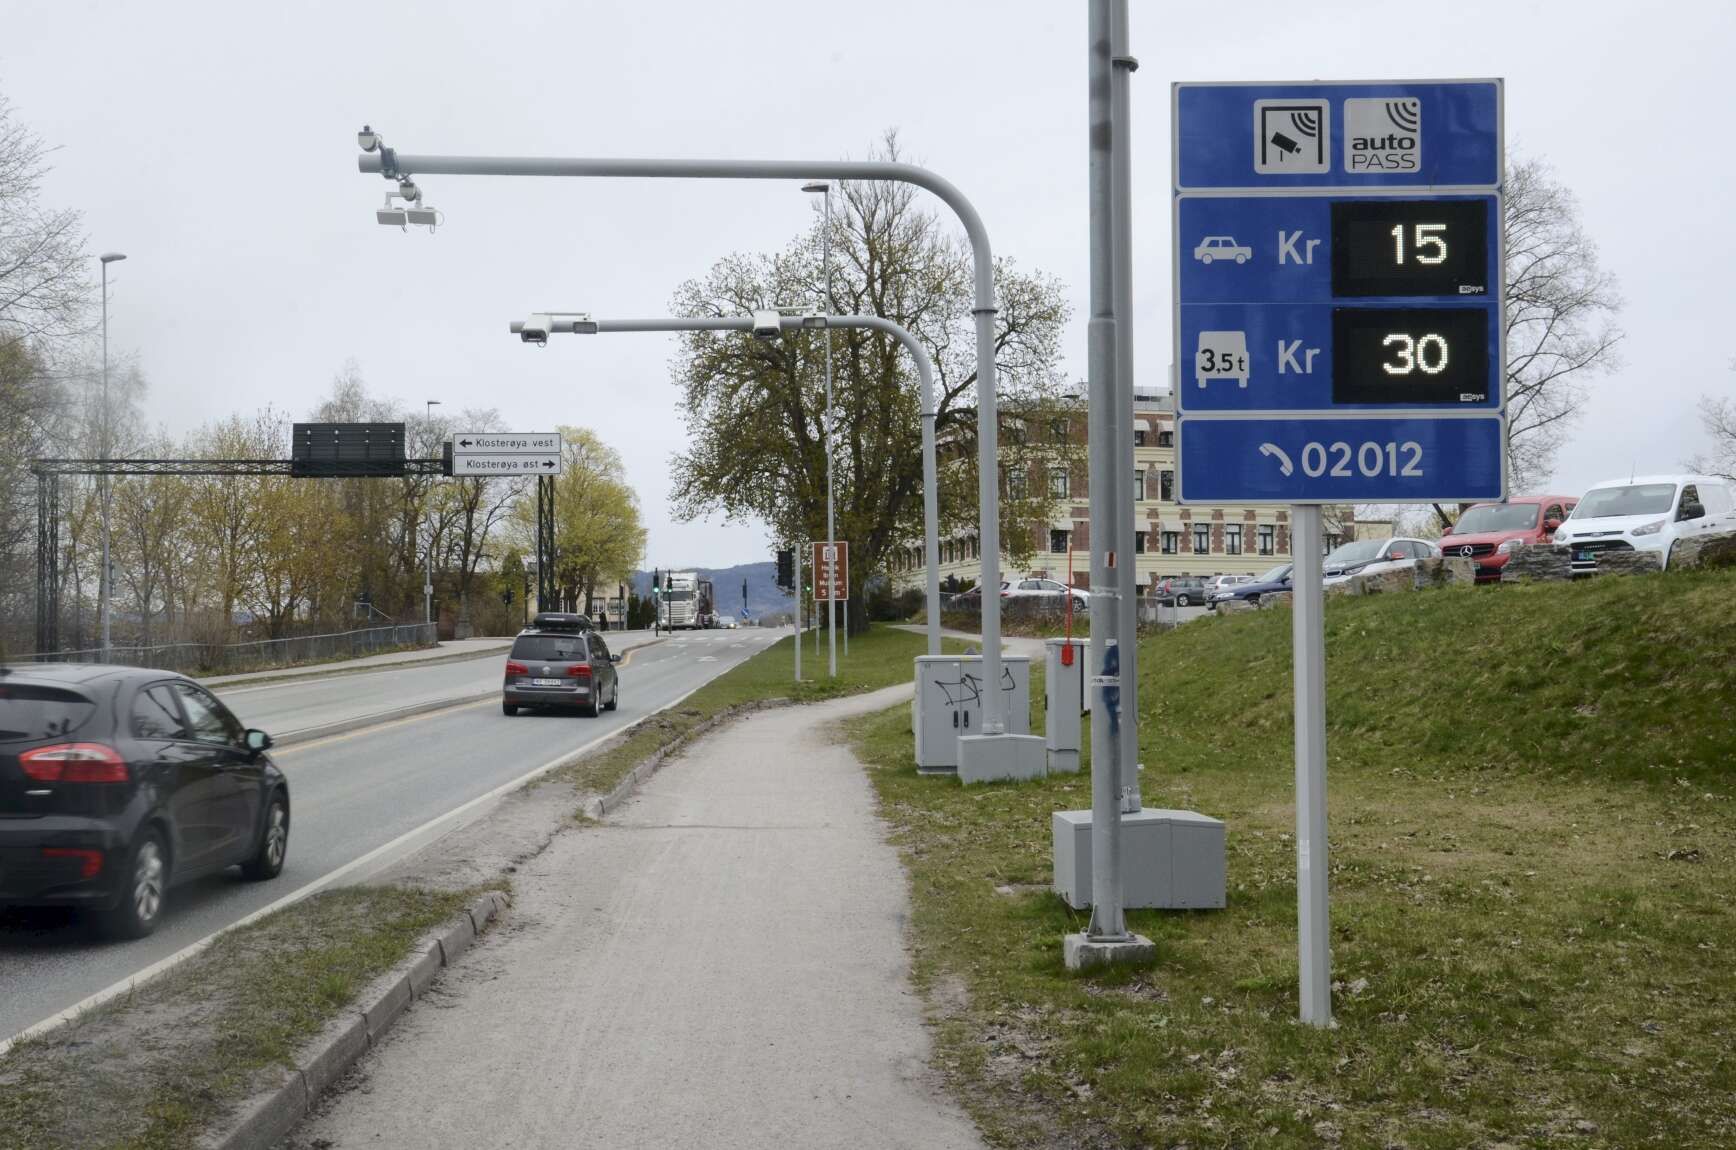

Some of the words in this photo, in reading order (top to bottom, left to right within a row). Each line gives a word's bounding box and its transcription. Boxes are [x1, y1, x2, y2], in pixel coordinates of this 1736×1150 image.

[1352, 133, 1416, 151] auto
[1352, 153, 1416, 170] PASS
[1278, 230, 1321, 265] Kr
[1391, 223, 1447, 265] 15
[1200, 349, 1234, 374] 3,5
[1237, 354, 1245, 372] t
[1278, 339, 1321, 374] Kr
[1382, 333, 1448, 375] 30
[475, 439, 527, 449] Klosterøya
[532, 439, 553, 448] vest
[1301, 441, 1424, 477] 02012
[466, 459, 518, 470] Klosterøya
[523, 460, 539, 469] øst
